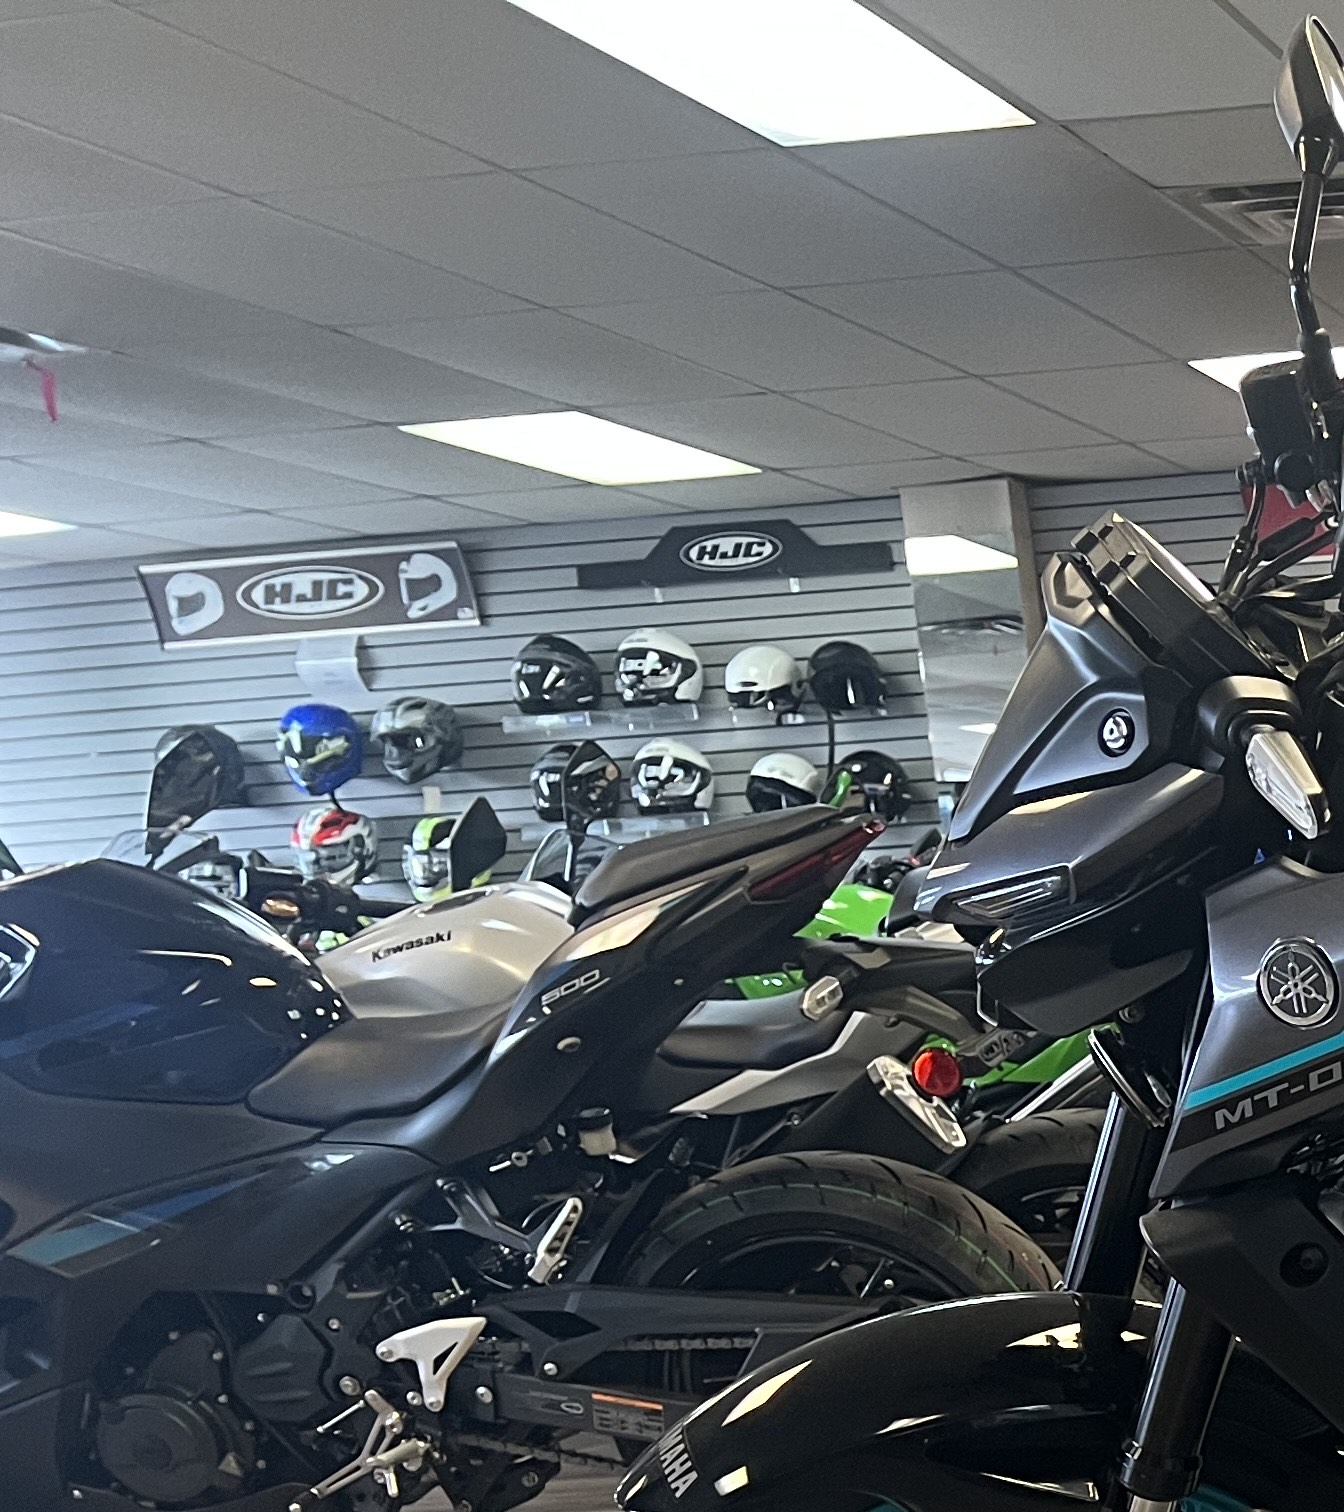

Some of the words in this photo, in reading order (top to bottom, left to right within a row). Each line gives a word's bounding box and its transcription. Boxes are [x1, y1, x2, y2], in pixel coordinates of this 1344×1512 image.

[696, 540, 766, 561] HJC
[263, 577, 355, 605] HJC
[372, 930, 452, 962] Kawasaki
[541, 969, 600, 1005] 500
